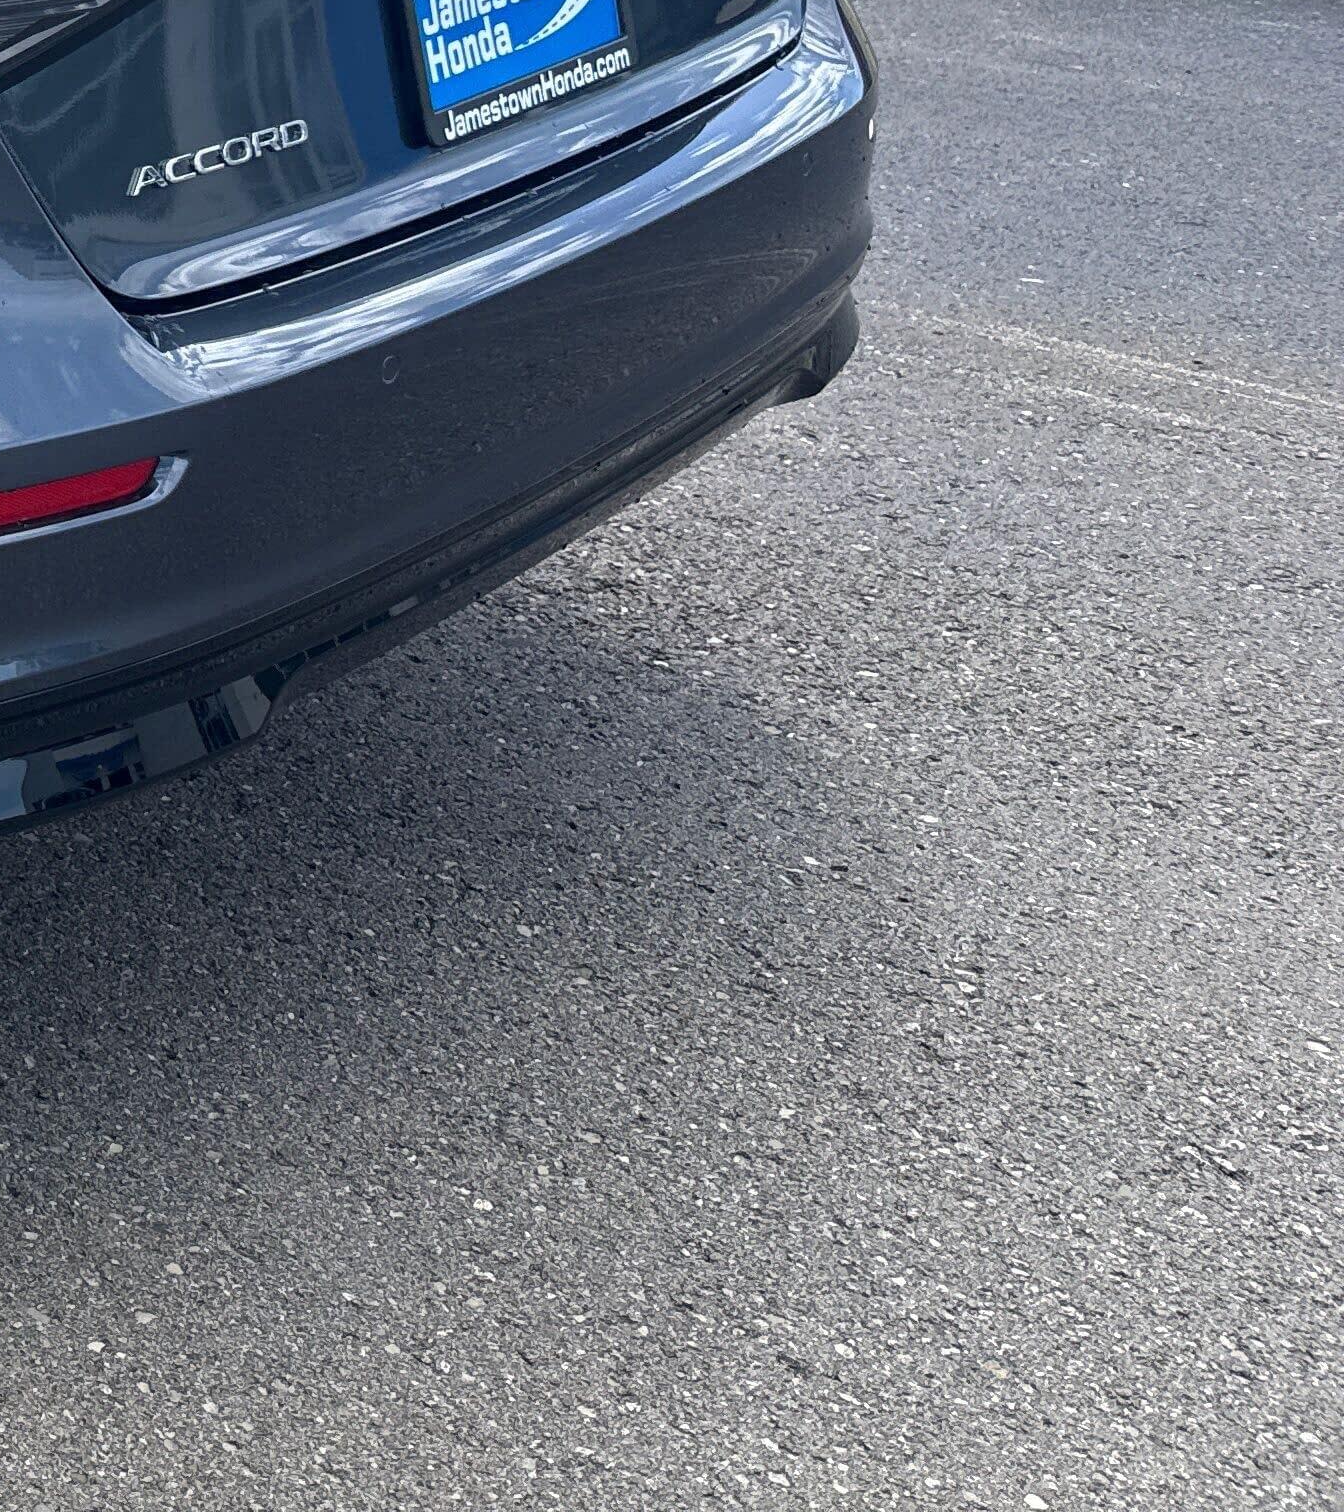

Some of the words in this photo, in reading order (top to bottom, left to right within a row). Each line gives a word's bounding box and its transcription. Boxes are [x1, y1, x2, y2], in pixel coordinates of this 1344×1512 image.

[425, 15, 515, 84] Honda
[443, 47, 632, 142] JamestownHonda.com
[125, 118, 309, 197] ACCORD
